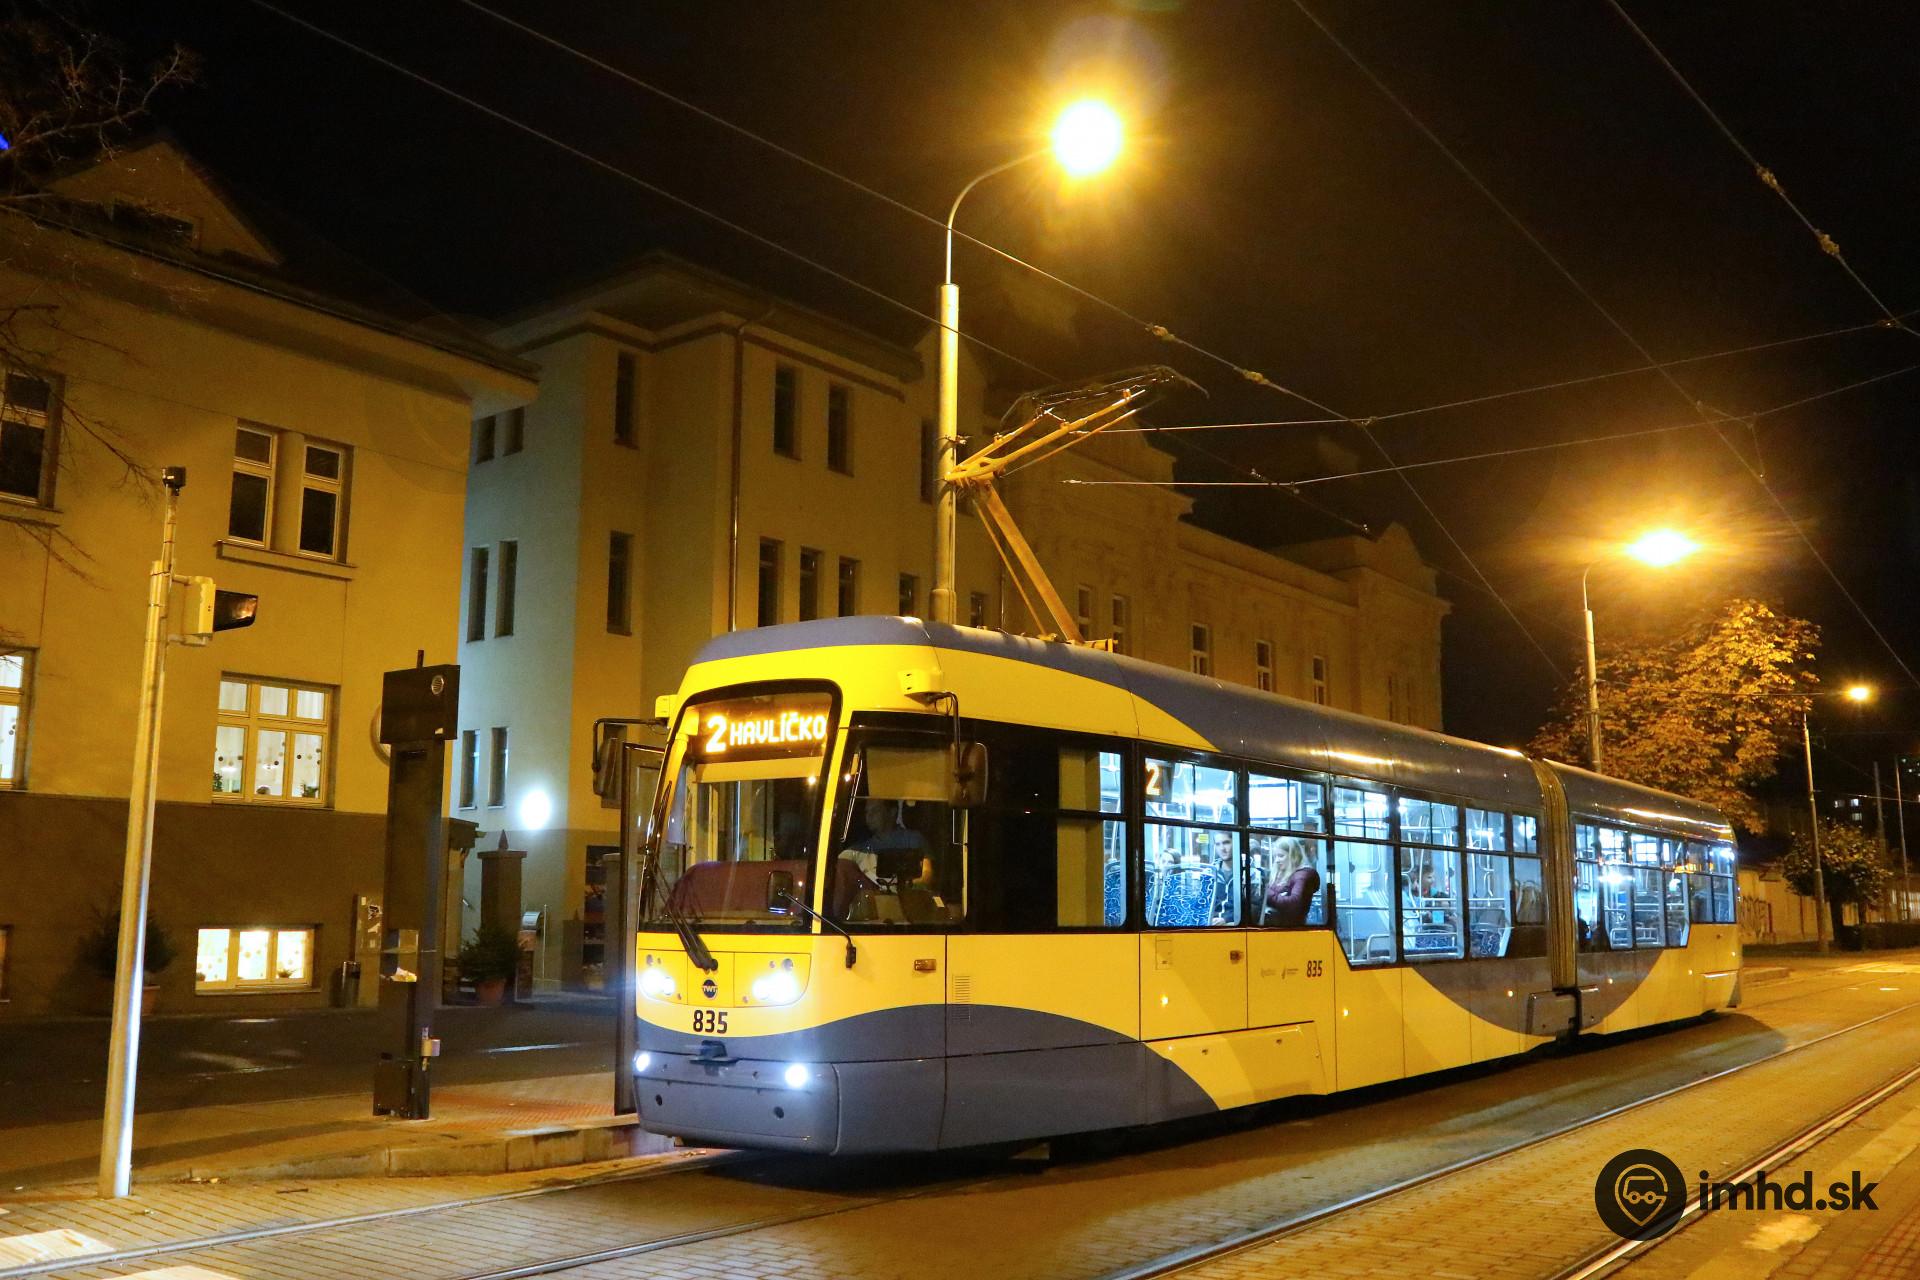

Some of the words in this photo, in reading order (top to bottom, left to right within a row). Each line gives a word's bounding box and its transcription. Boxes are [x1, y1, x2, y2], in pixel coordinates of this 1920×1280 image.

[705, 713, 727, 753] 2
[729, 711, 827, 746] HAVLÍČKO
[1145, 763, 1161, 796] 2
[1306, 960, 1323, 978] 835
[693, 1009, 728, 1034] 835
